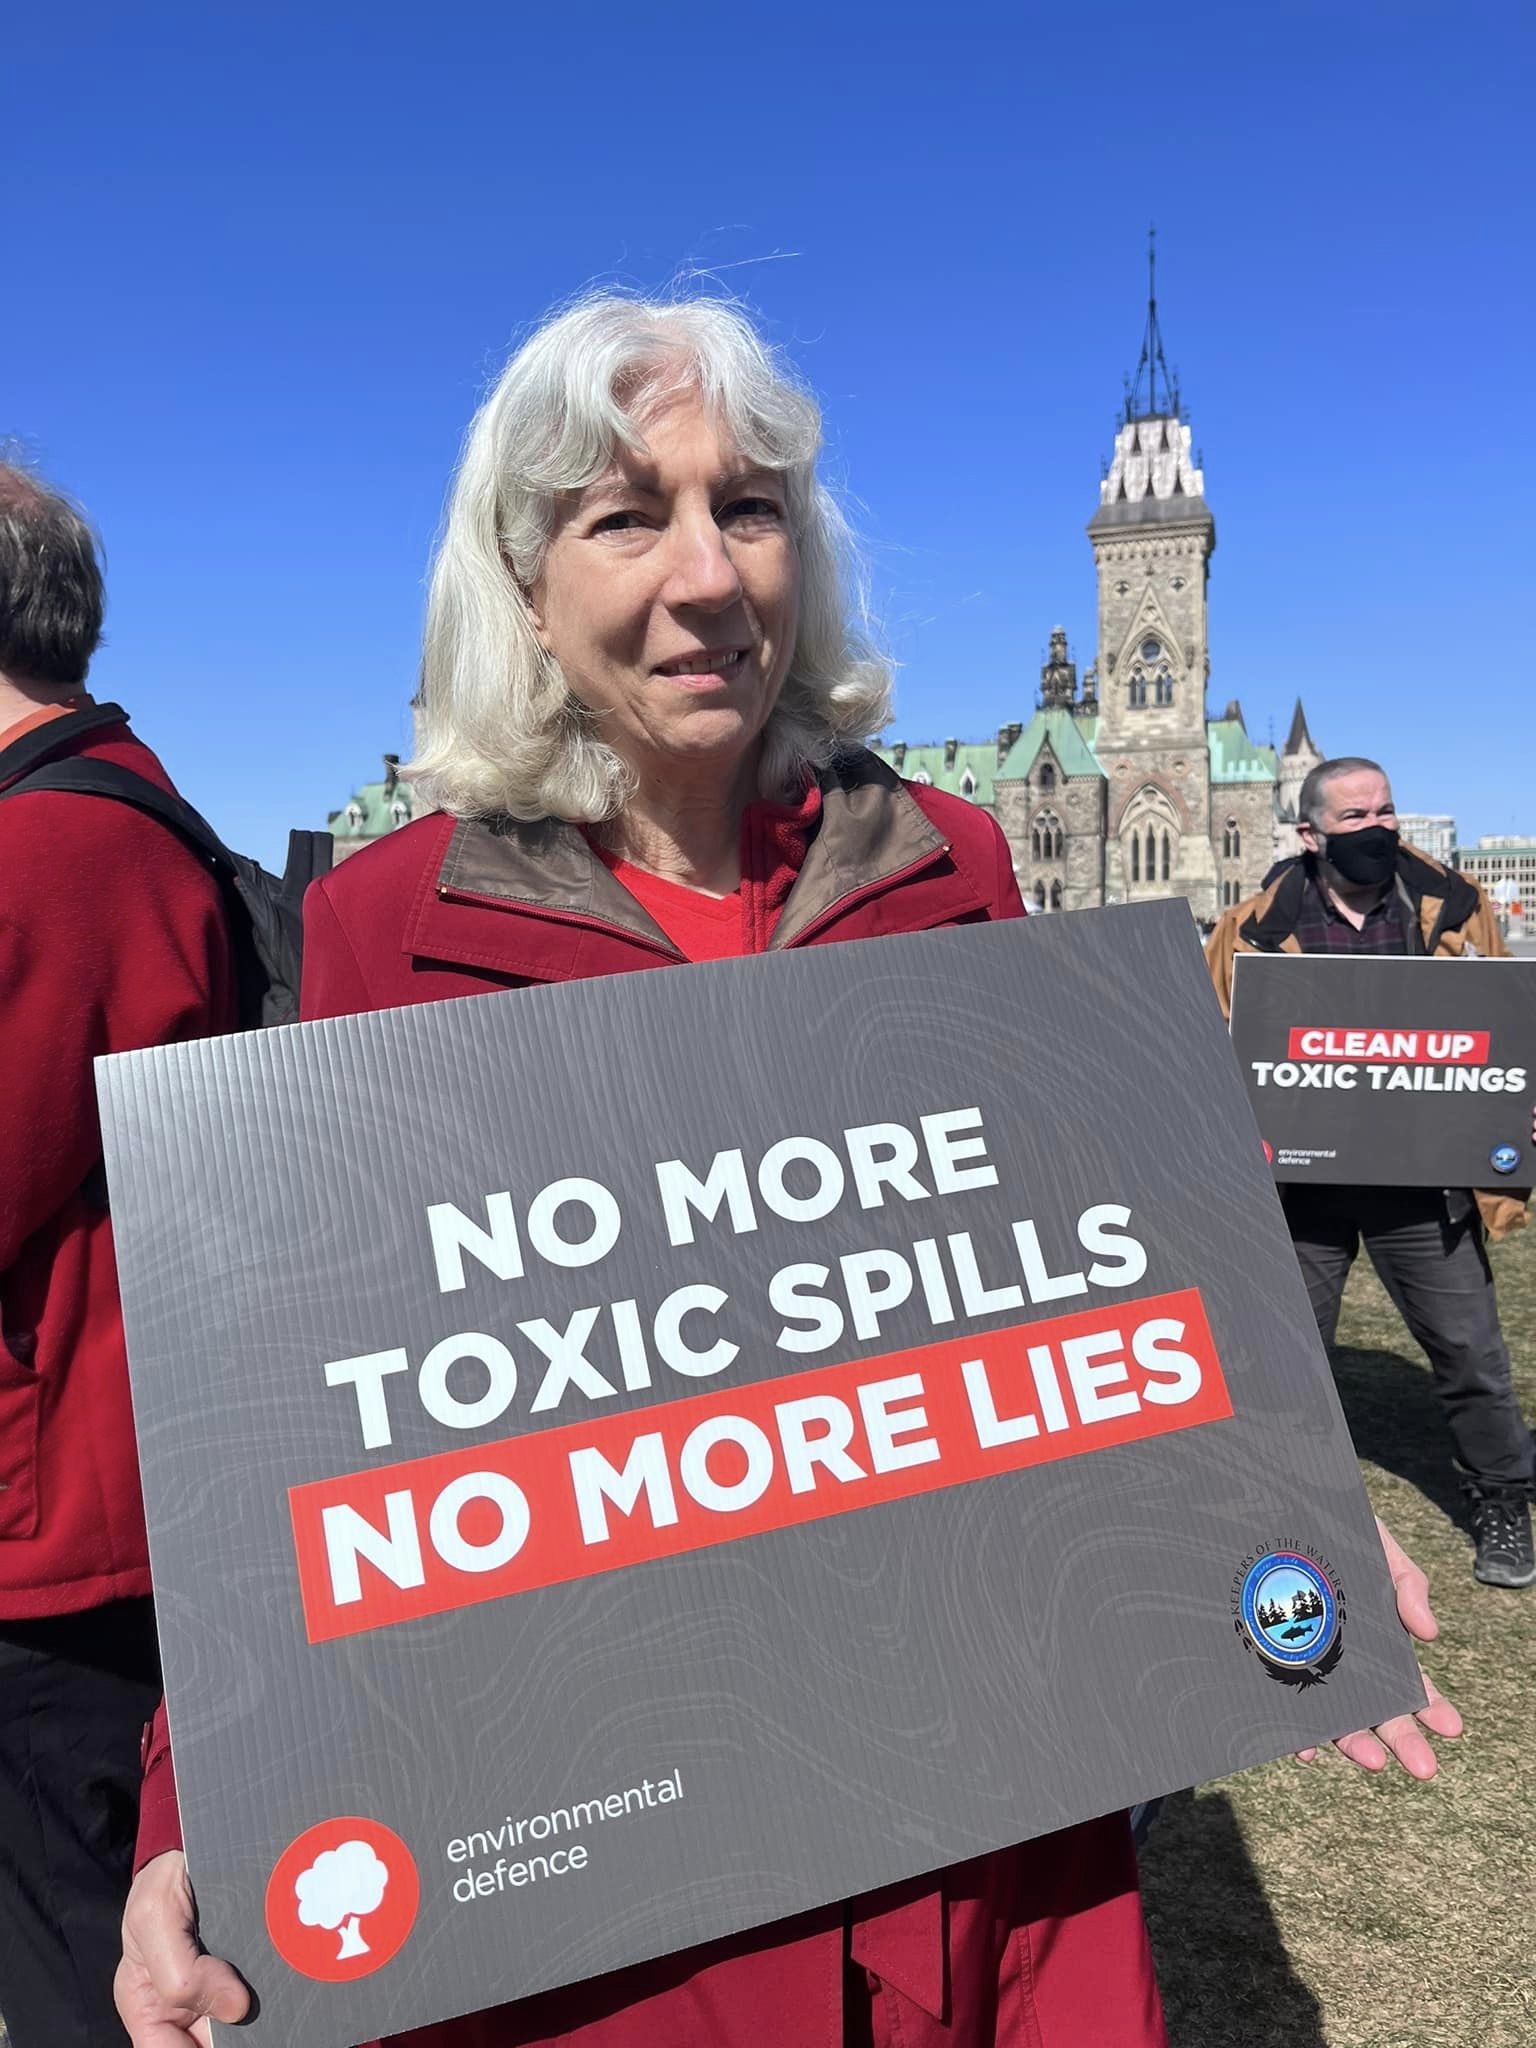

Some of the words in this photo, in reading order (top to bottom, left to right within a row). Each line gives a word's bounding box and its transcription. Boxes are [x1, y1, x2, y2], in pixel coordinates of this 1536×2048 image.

[1251, 1062, 1358, 1089] TOXIC
[1366, 1066, 1527, 1093] TAILINGS
[1300, 1031, 1418, 1058] CLEAN
[1426, 1034, 1474, 1059] UP
[1278, 1149, 1336, 1158] environmental
[1278, 1157, 1311, 1166] defence
[427, 1178, 621, 1294] NO
[655, 1107, 1000, 1247] MORE
[324, 1283, 741, 1450] TOXIC
[768, 1203, 1149, 1353] SPILLS
[321, 1471, 531, 1606] NO
[568, 1373, 941, 1545] MORE
[960, 1318, 1203, 1449] LIES
[1230, 1553, 1255, 1615] KEEPERS
[1255, 1540, 1272, 1555] OF
[1275, 1537, 1301, 1550] THE
[1305, 1545, 1342, 1588] WATER
[446, 1768, 684, 1863] environmental
[452, 1845, 588, 1903] defence
